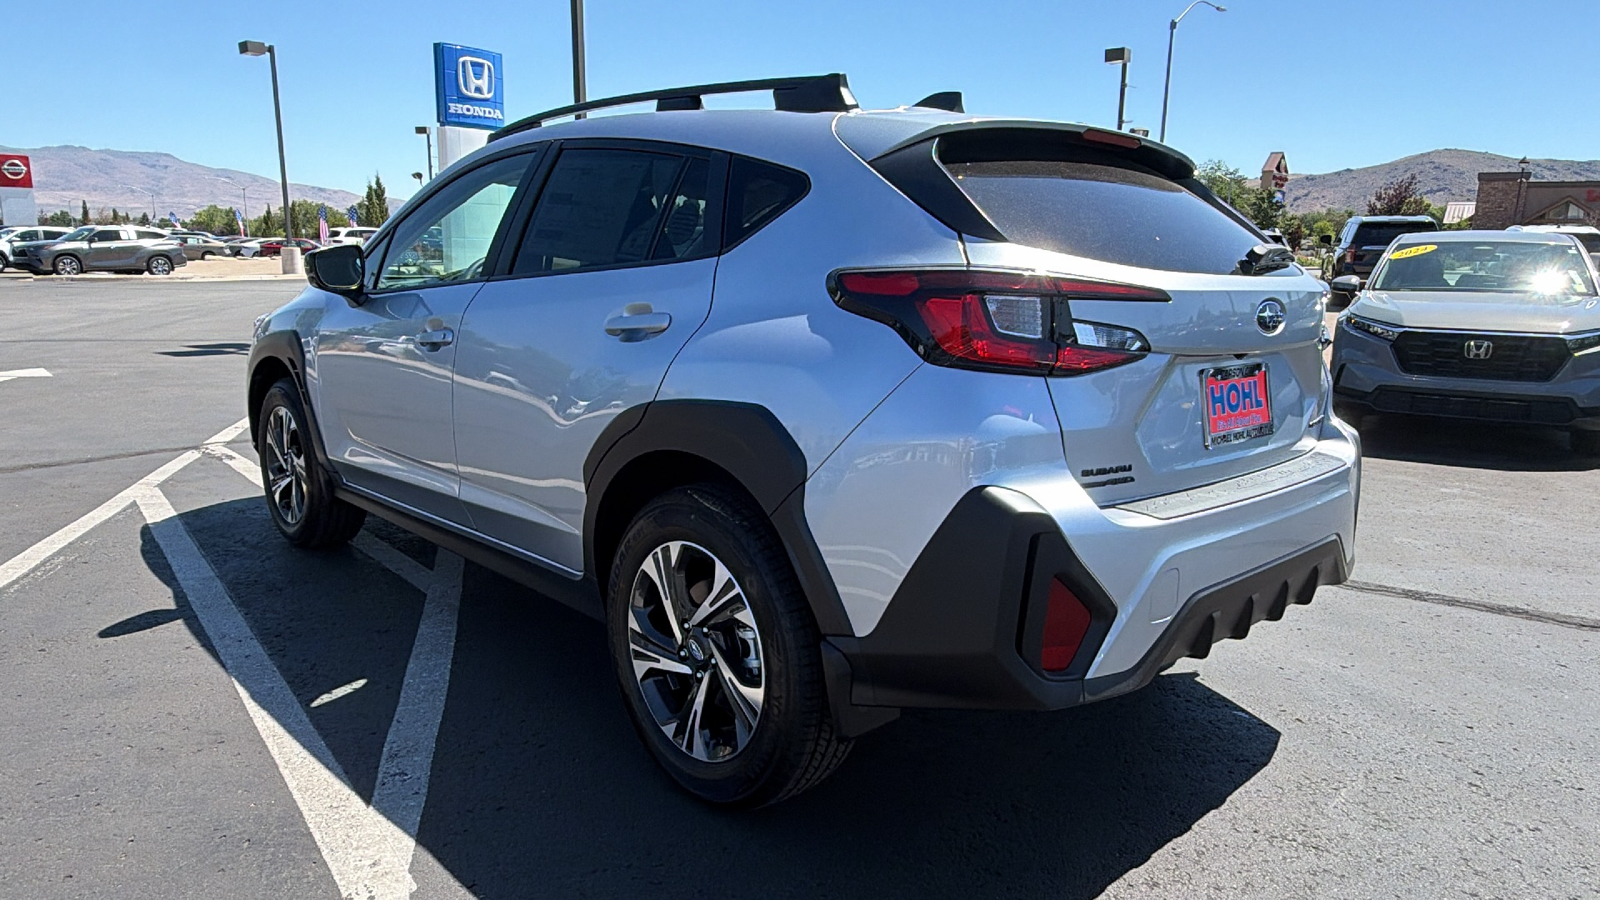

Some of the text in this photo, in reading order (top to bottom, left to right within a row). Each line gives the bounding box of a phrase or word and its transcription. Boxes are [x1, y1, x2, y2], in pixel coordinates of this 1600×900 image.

[448, 103, 503, 119] HONDA
[1398, 247, 1428, 258] 2024
[1209, 380, 1263, 417] HOHL
[1211, 433, 1232, 445] MICHAEL
[1233, 430, 1246, 441] HOHL
[1081, 464, 1132, 477] SUBARU
